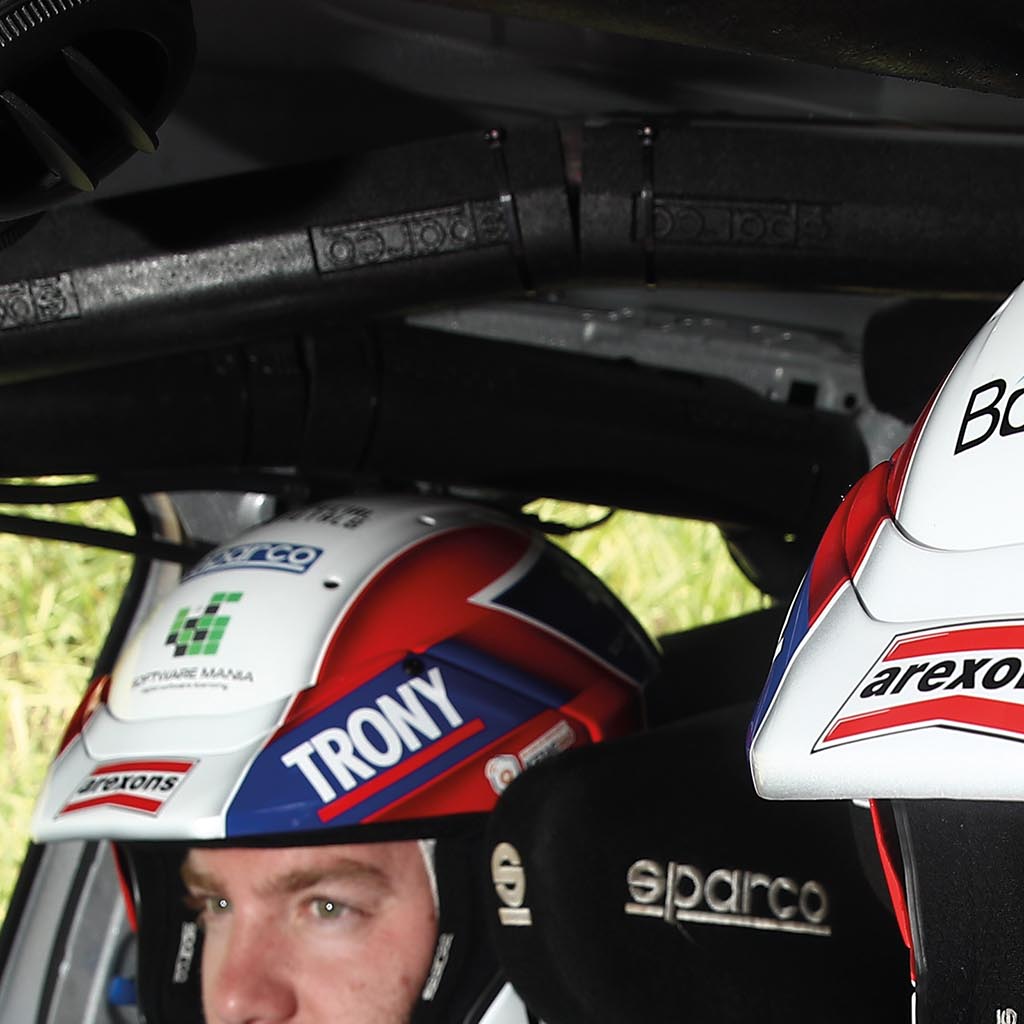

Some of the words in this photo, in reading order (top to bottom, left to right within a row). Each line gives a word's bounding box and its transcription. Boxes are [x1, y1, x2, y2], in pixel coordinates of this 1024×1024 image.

[281, 669, 464, 803] TRONY
[78, 775, 178, 794] arexons
[625, 859, 831, 932] sparco
